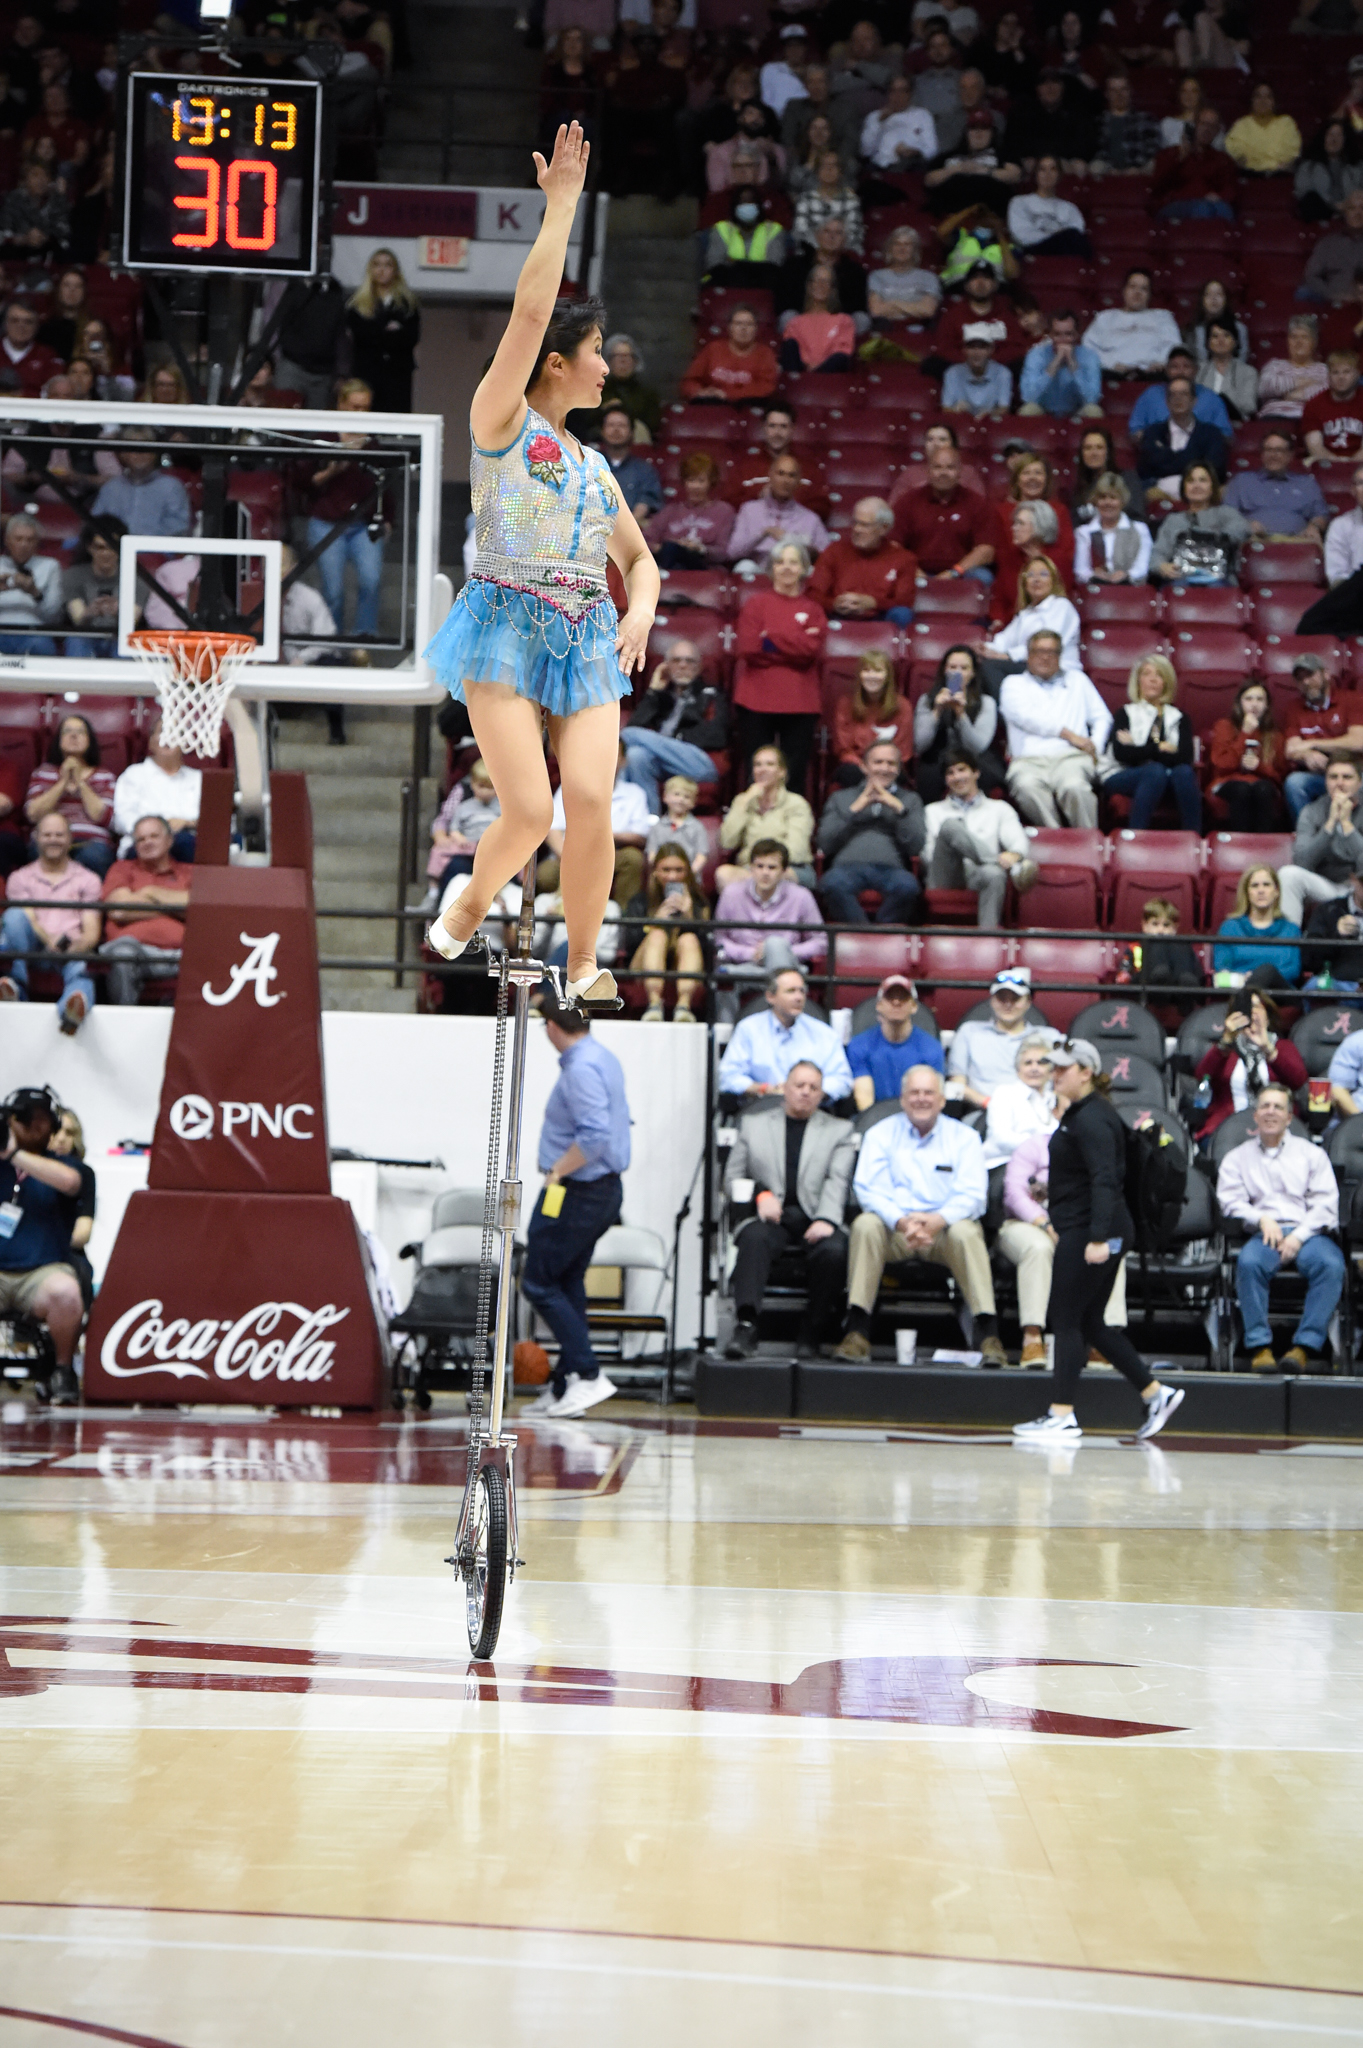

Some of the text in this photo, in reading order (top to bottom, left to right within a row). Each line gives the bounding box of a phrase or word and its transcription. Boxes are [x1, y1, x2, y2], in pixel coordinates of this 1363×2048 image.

[177, 82, 270, 98] DAKTRONICS
[172, 96, 298, 152] 13:13
[172, 155, 279, 252] 30
[346, 194, 370, 226] J
[497, 202, 521, 230] K
[426, 238, 462, 265] EXIT
[201, 932, 282, 1008] A
[221, 1101, 315, 1140] PNC
[101, 1298, 351, 1383] Coca-Cola
